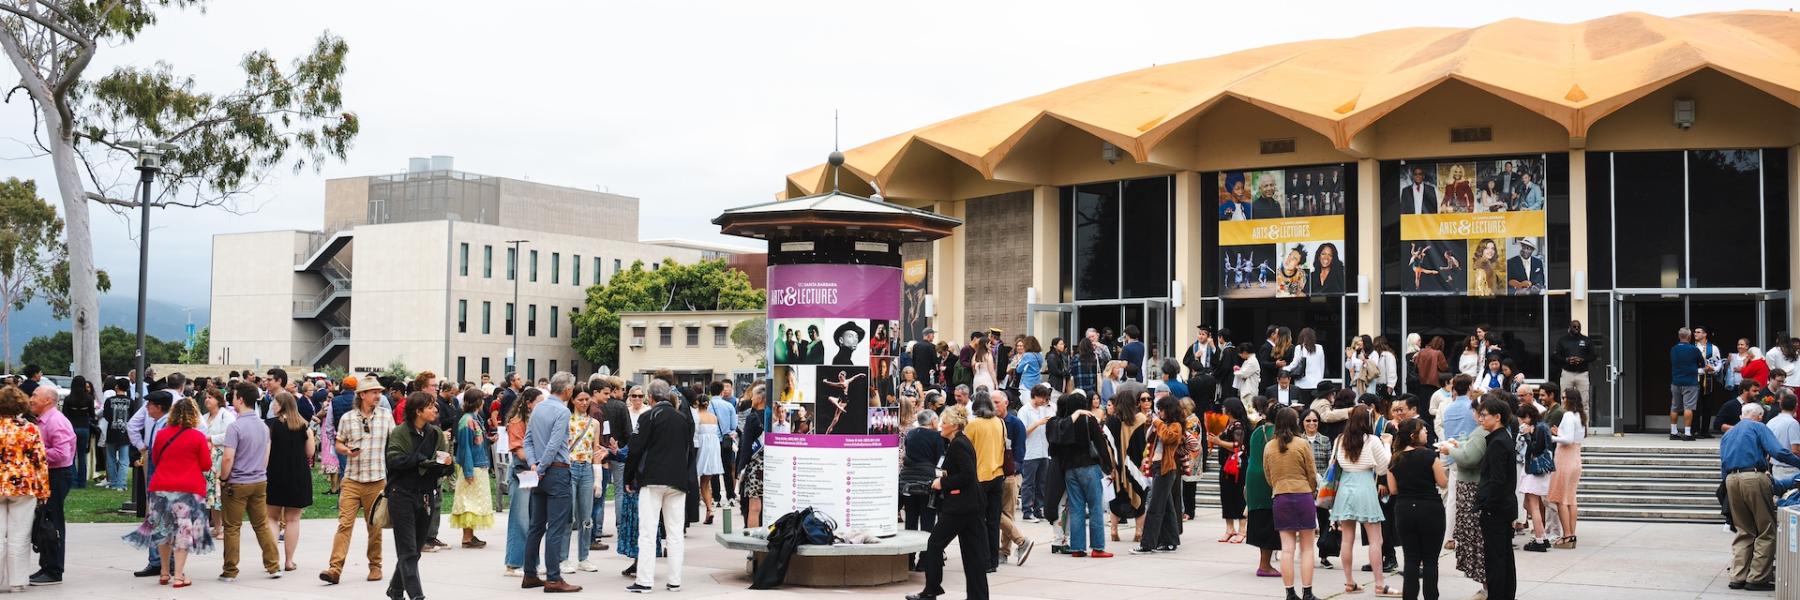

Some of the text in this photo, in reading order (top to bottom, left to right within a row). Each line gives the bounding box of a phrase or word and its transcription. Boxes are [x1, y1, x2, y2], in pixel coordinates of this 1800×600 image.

[1253, 224, 1310, 240] ARTS & LECTURES
[1440, 219, 1505, 236] ARTS & LECTURES
[771, 286, 837, 306] ARTS & LECTURES
